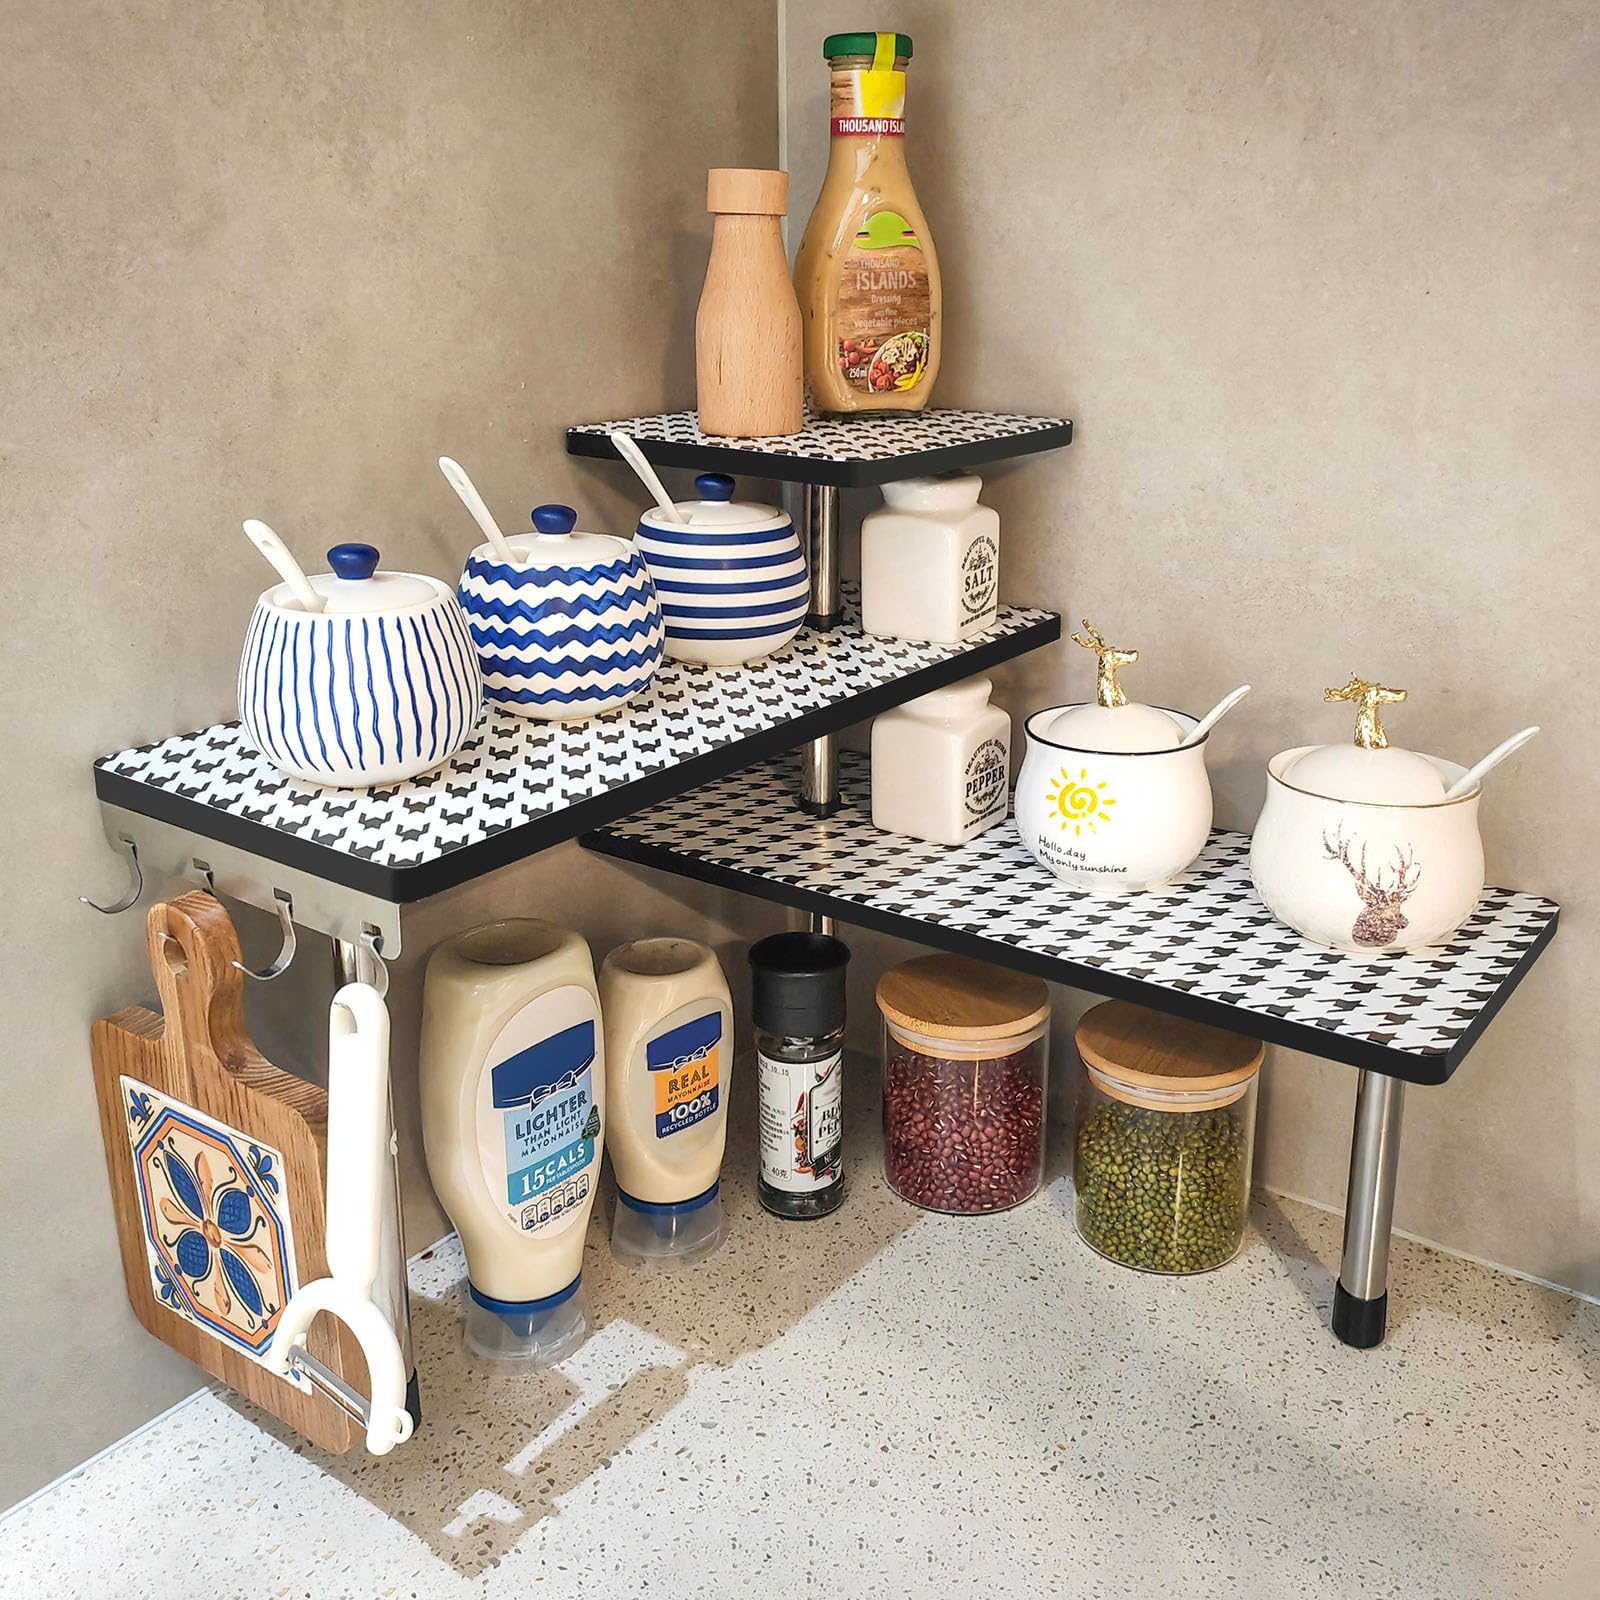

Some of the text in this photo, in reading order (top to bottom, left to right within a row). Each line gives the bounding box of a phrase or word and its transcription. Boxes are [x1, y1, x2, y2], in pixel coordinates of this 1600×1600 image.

[838, 119, 905, 133] THOUSAND ISLA
[860, 257, 900, 269] THOUSAND
[856, 270, 917, 291] ISLANDS
[871, 294, 901, 305] Dressing
[854, 318, 892, 330] vegetable
[965, 565, 994, 593] SALT
[965, 765, 1005, 799] PEPPER
[1039, 848, 1128, 874] My only sunshine
[667, 1078, 711, 1104] MAYONNAISE
[668, 1064, 710, 1095] REAL
[515, 1090, 588, 1140] LIGHTER
[661, 1101, 717, 1134] RECYCLED BOTTLE
[668, 1091, 712, 1123] 100%
[521, 1117, 585, 1158] MAYONNAISE
[523, 1127, 551, 1146] THAN
[555, 1109, 582, 1131] LIGHT
